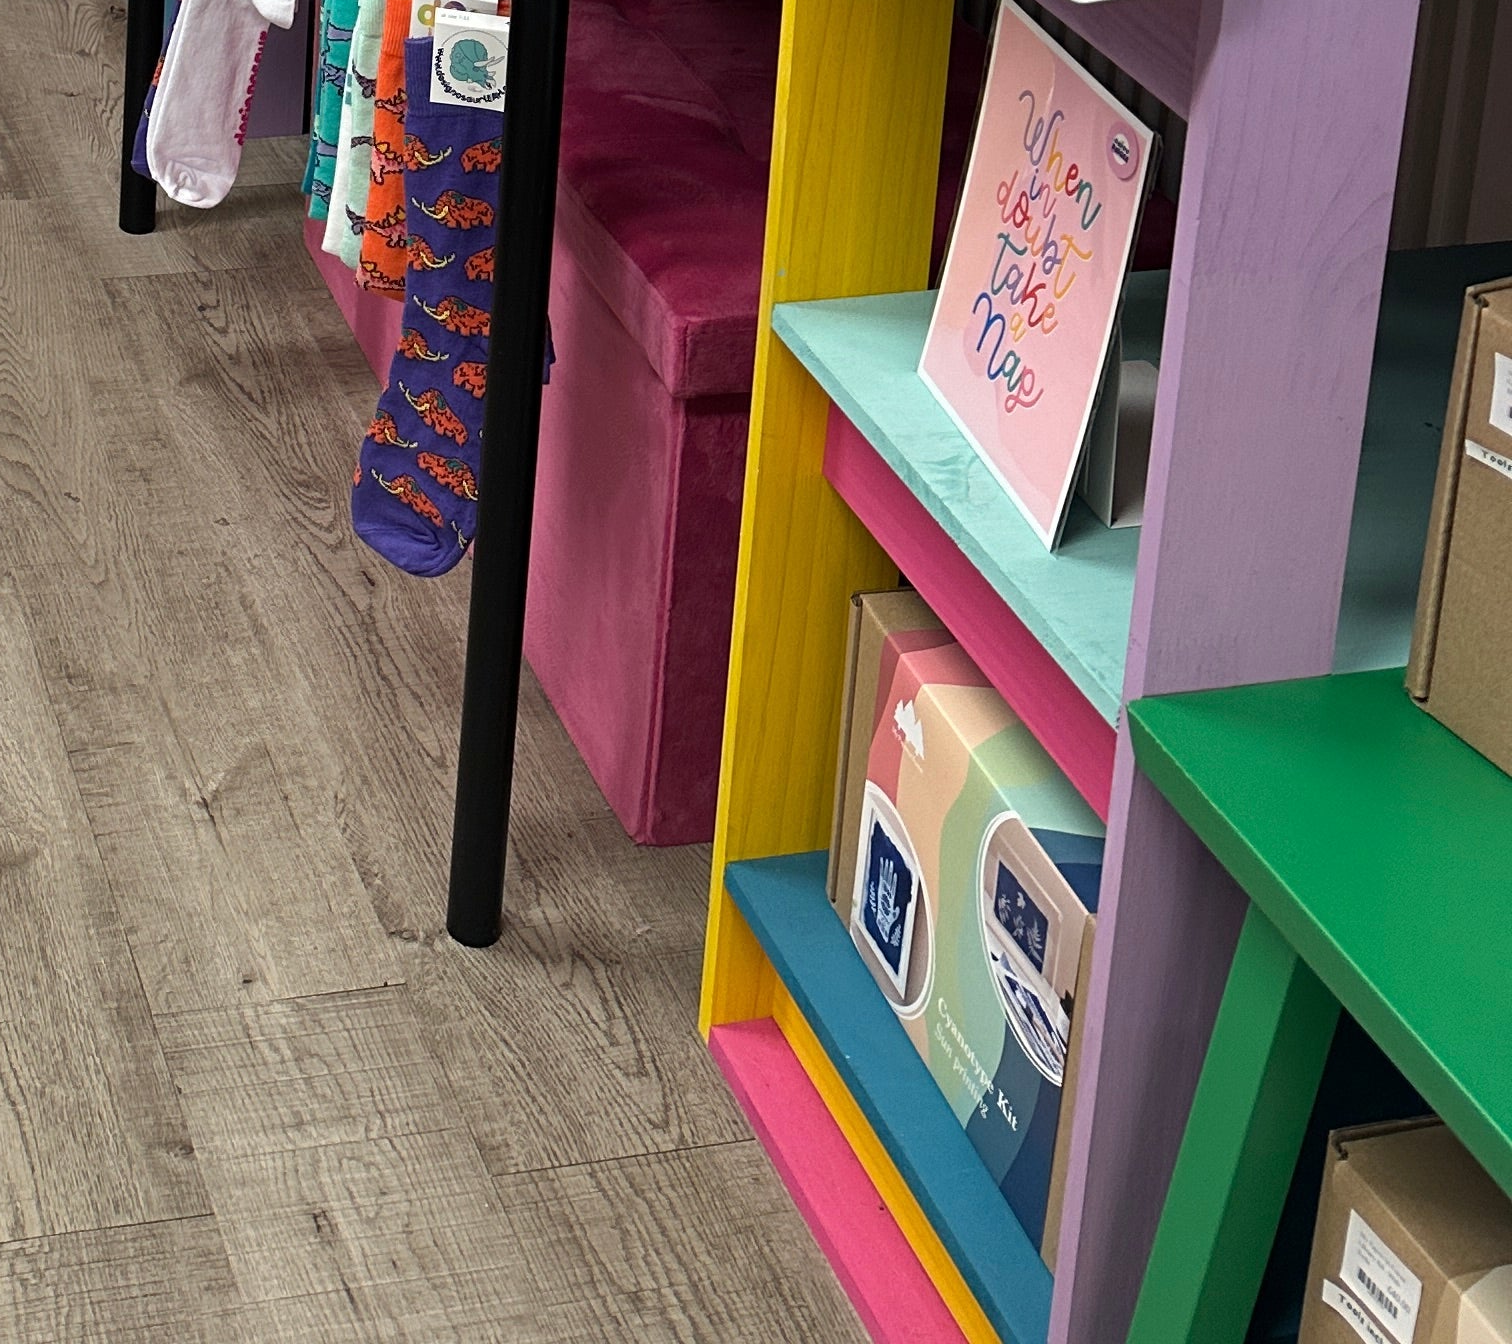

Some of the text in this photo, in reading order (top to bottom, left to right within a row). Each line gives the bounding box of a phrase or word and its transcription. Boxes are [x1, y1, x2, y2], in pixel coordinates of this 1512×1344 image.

[1018, 89, 1102, 230] When
[1029, 168, 1056, 219] in
[996, 170, 1093, 299] doubt
[1009, 312, 1026, 343] a
[934, 1022, 989, 1120] Sun printing
[938, 996, 1018, 1132] Cyanotype Kit
